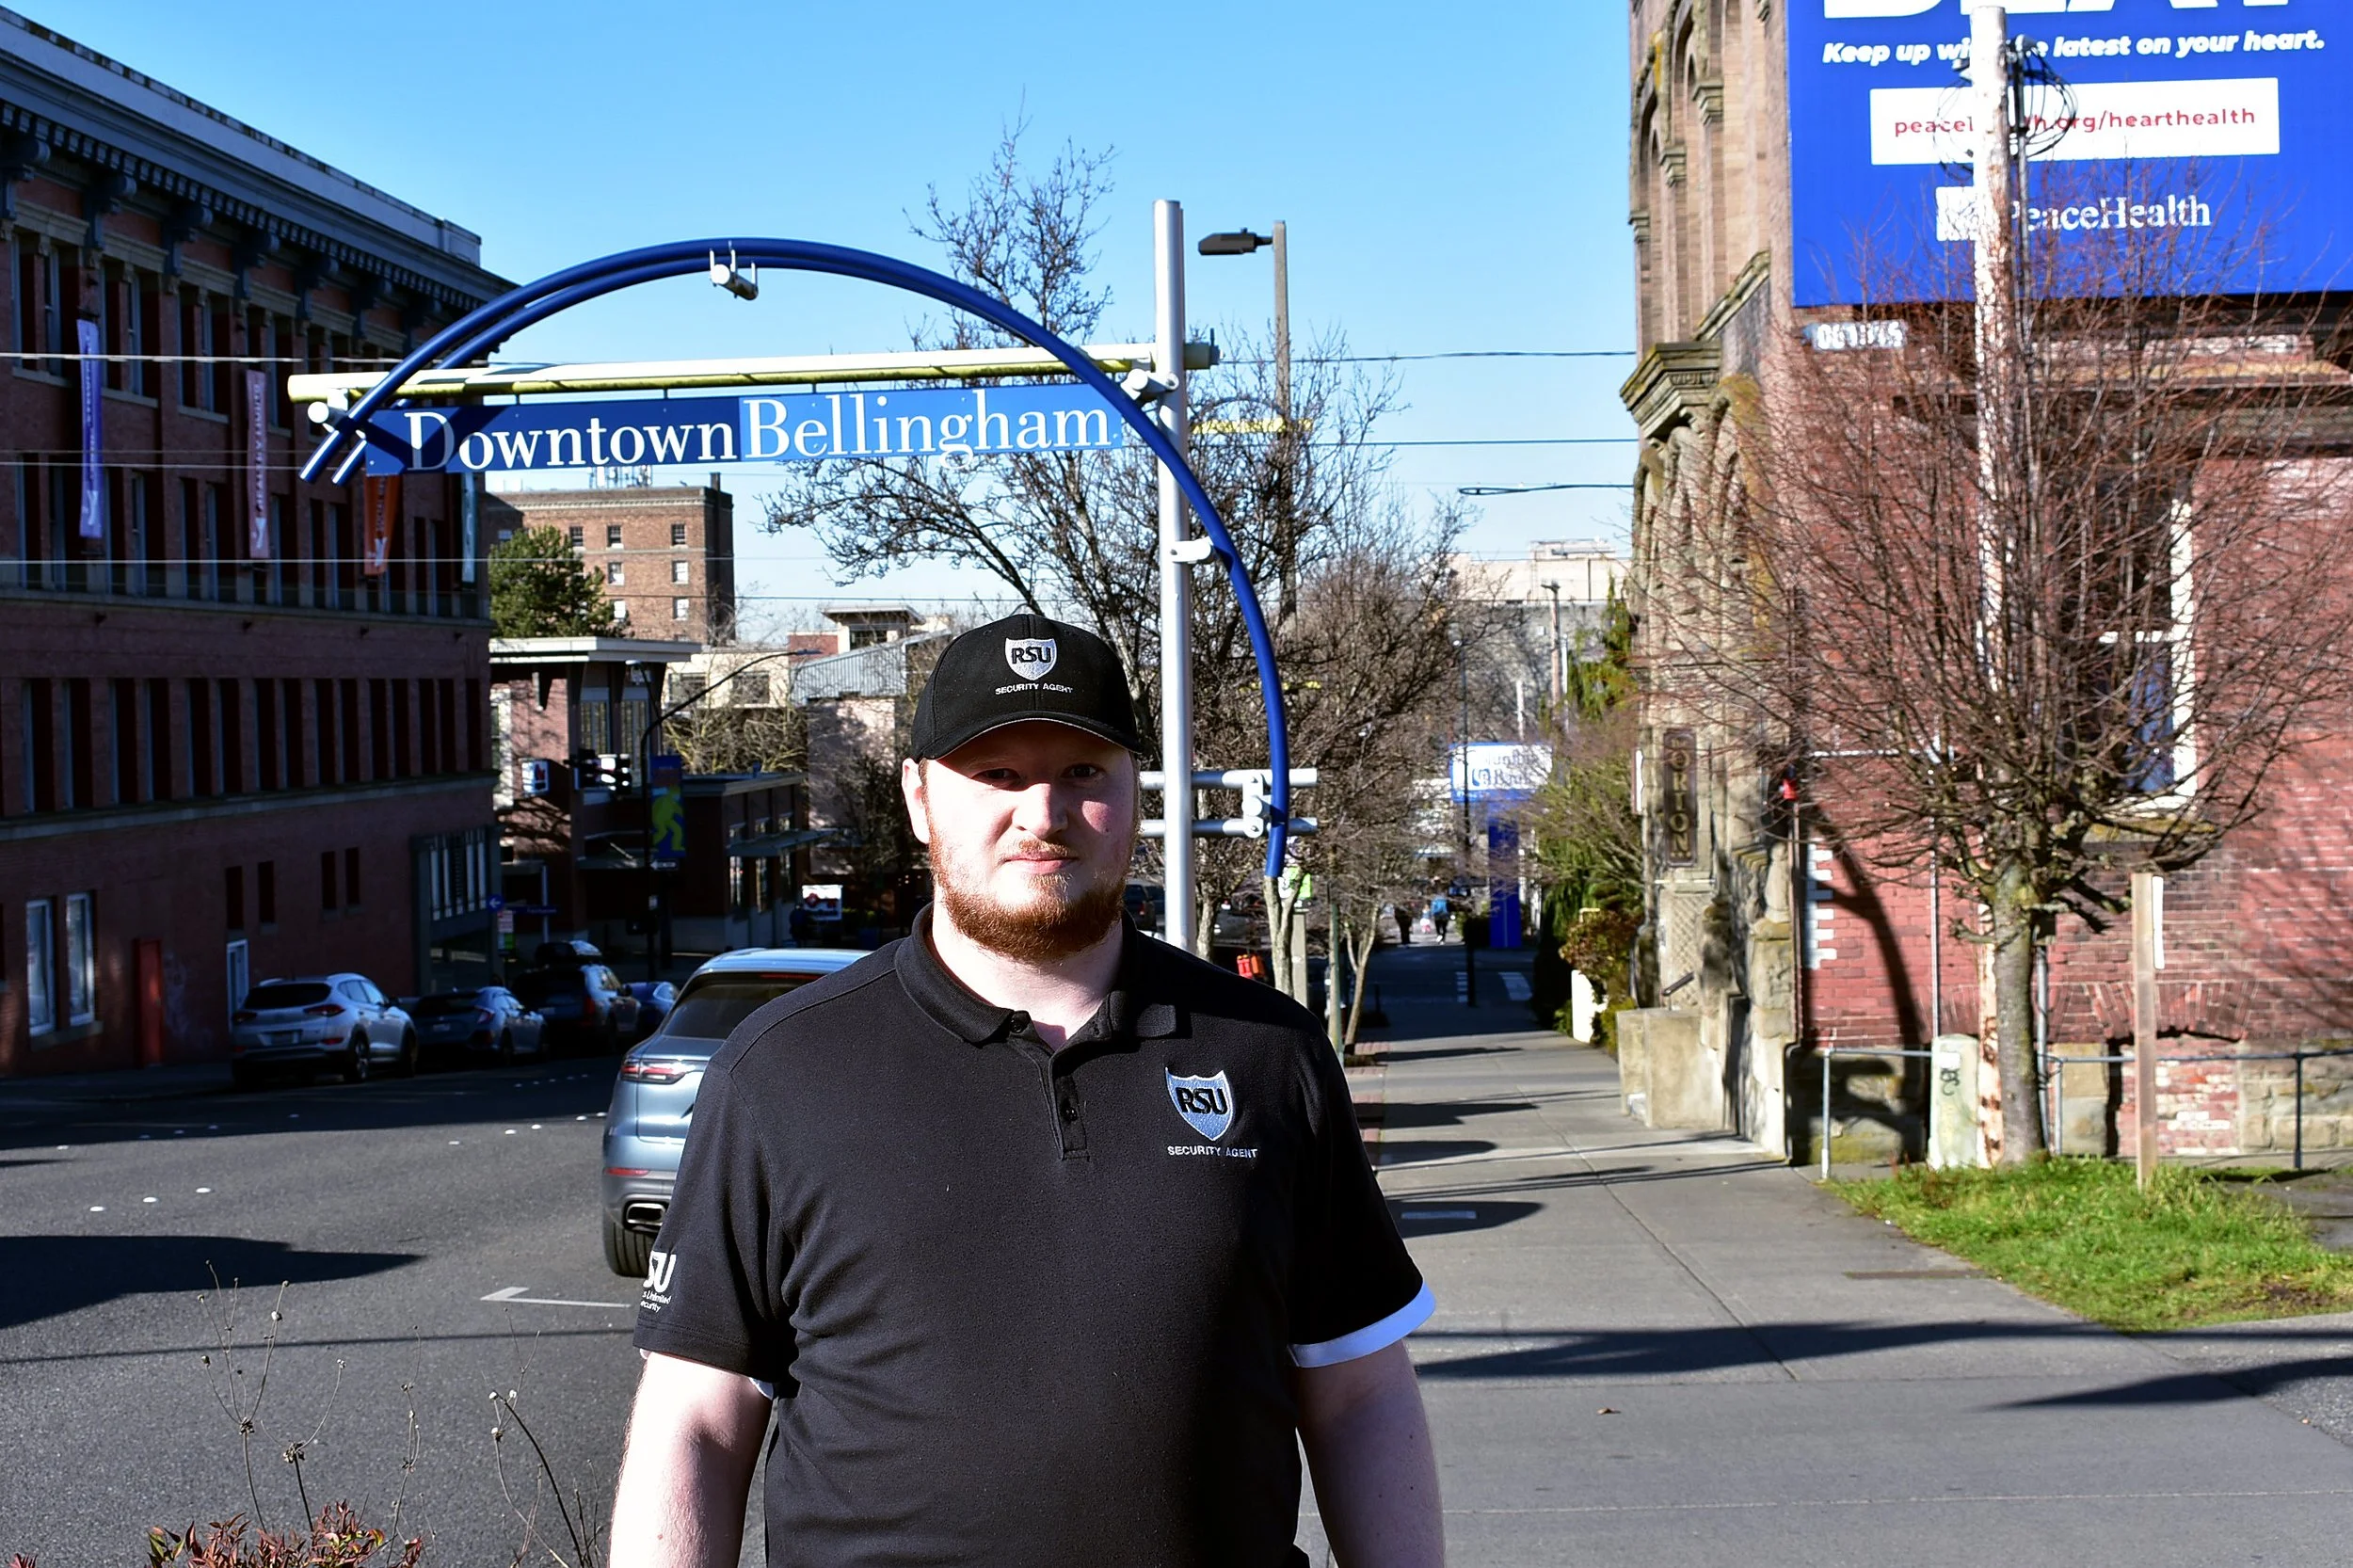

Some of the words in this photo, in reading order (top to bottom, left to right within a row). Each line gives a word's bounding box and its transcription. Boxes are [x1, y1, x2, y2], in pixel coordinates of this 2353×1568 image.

[1822, 42, 1891, 67] Keep
[1896, 43, 1931, 66] up
[2053, 36, 2131, 57] latest
[2137, 37, 2171, 55] on
[2175, 34, 2239, 59] your
[2243, 29, 2325, 52] heart.
[404, 410, 738, 472] Downtown
[743, 389, 1112, 471] Bellingham
[1011, 646, 1051, 664] RSU
[995, 683, 1039, 695] SECURITY
[1043, 682, 1073, 693] AGENT
[1175, 1087, 1228, 1115] RSU
[1167, 1145, 1221, 1156] SECURITY
[1225, 1147, 1257, 1158] AGENT
